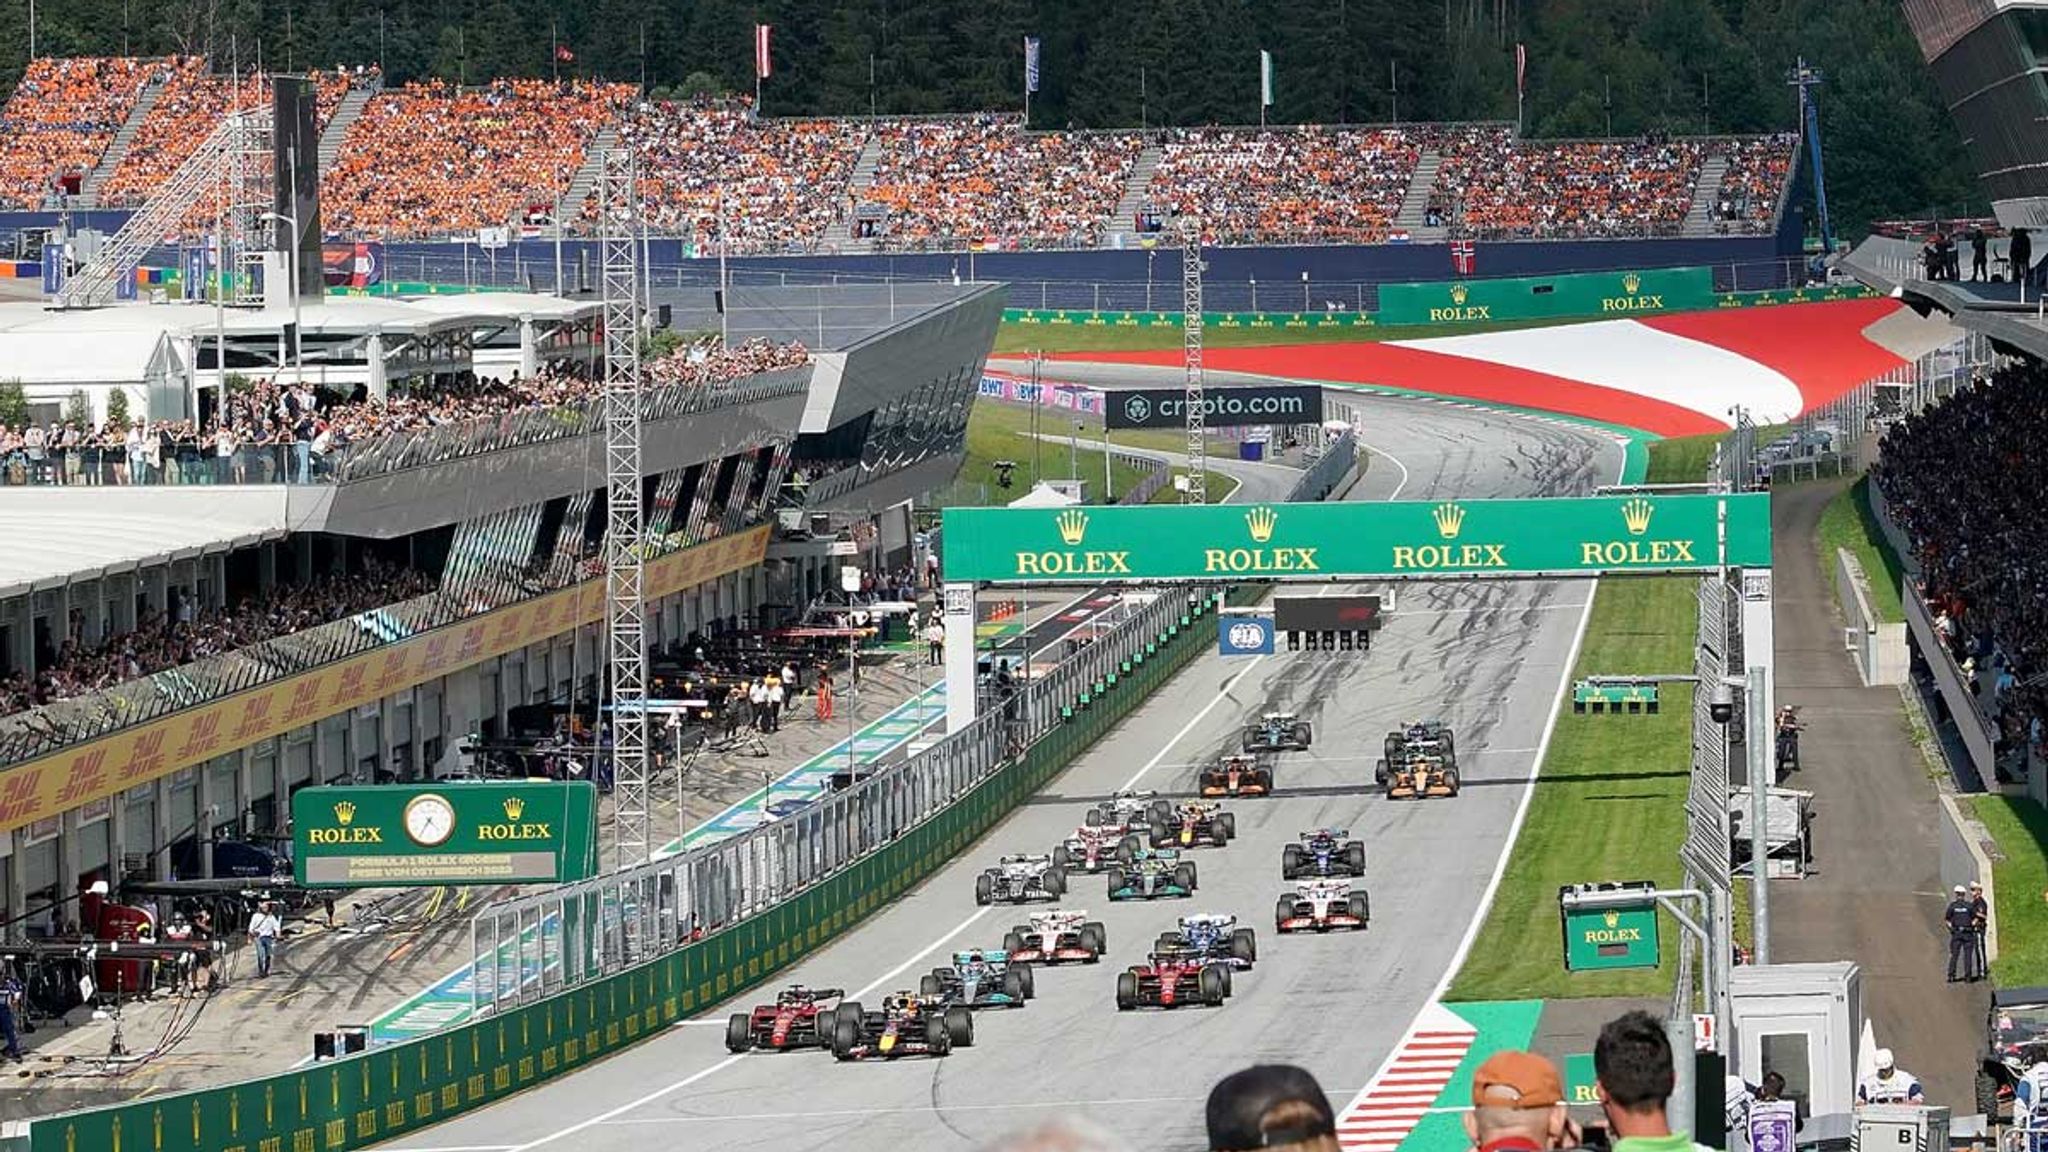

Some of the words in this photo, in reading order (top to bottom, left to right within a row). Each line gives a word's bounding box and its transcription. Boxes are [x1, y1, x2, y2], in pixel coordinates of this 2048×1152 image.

[1602, 295, 1664, 311] ROLEX
[1429, 306, 1490, 321] ROLEX
[1159, 395, 1304, 419] crpto.com
[1204, 548, 1320, 572] ROLEX
[1392, 544, 1508, 568] ROLEX
[1581, 540, 1695, 564] ROLEX
[1016, 551, 1131, 574] ROLEX
[308, 827, 383, 844] ROLEX
[478, 823, 552, 841] ROLEX
[1584, 928, 1641, 943] ROLEX
[1898, 1129, 1911, 1143] B
